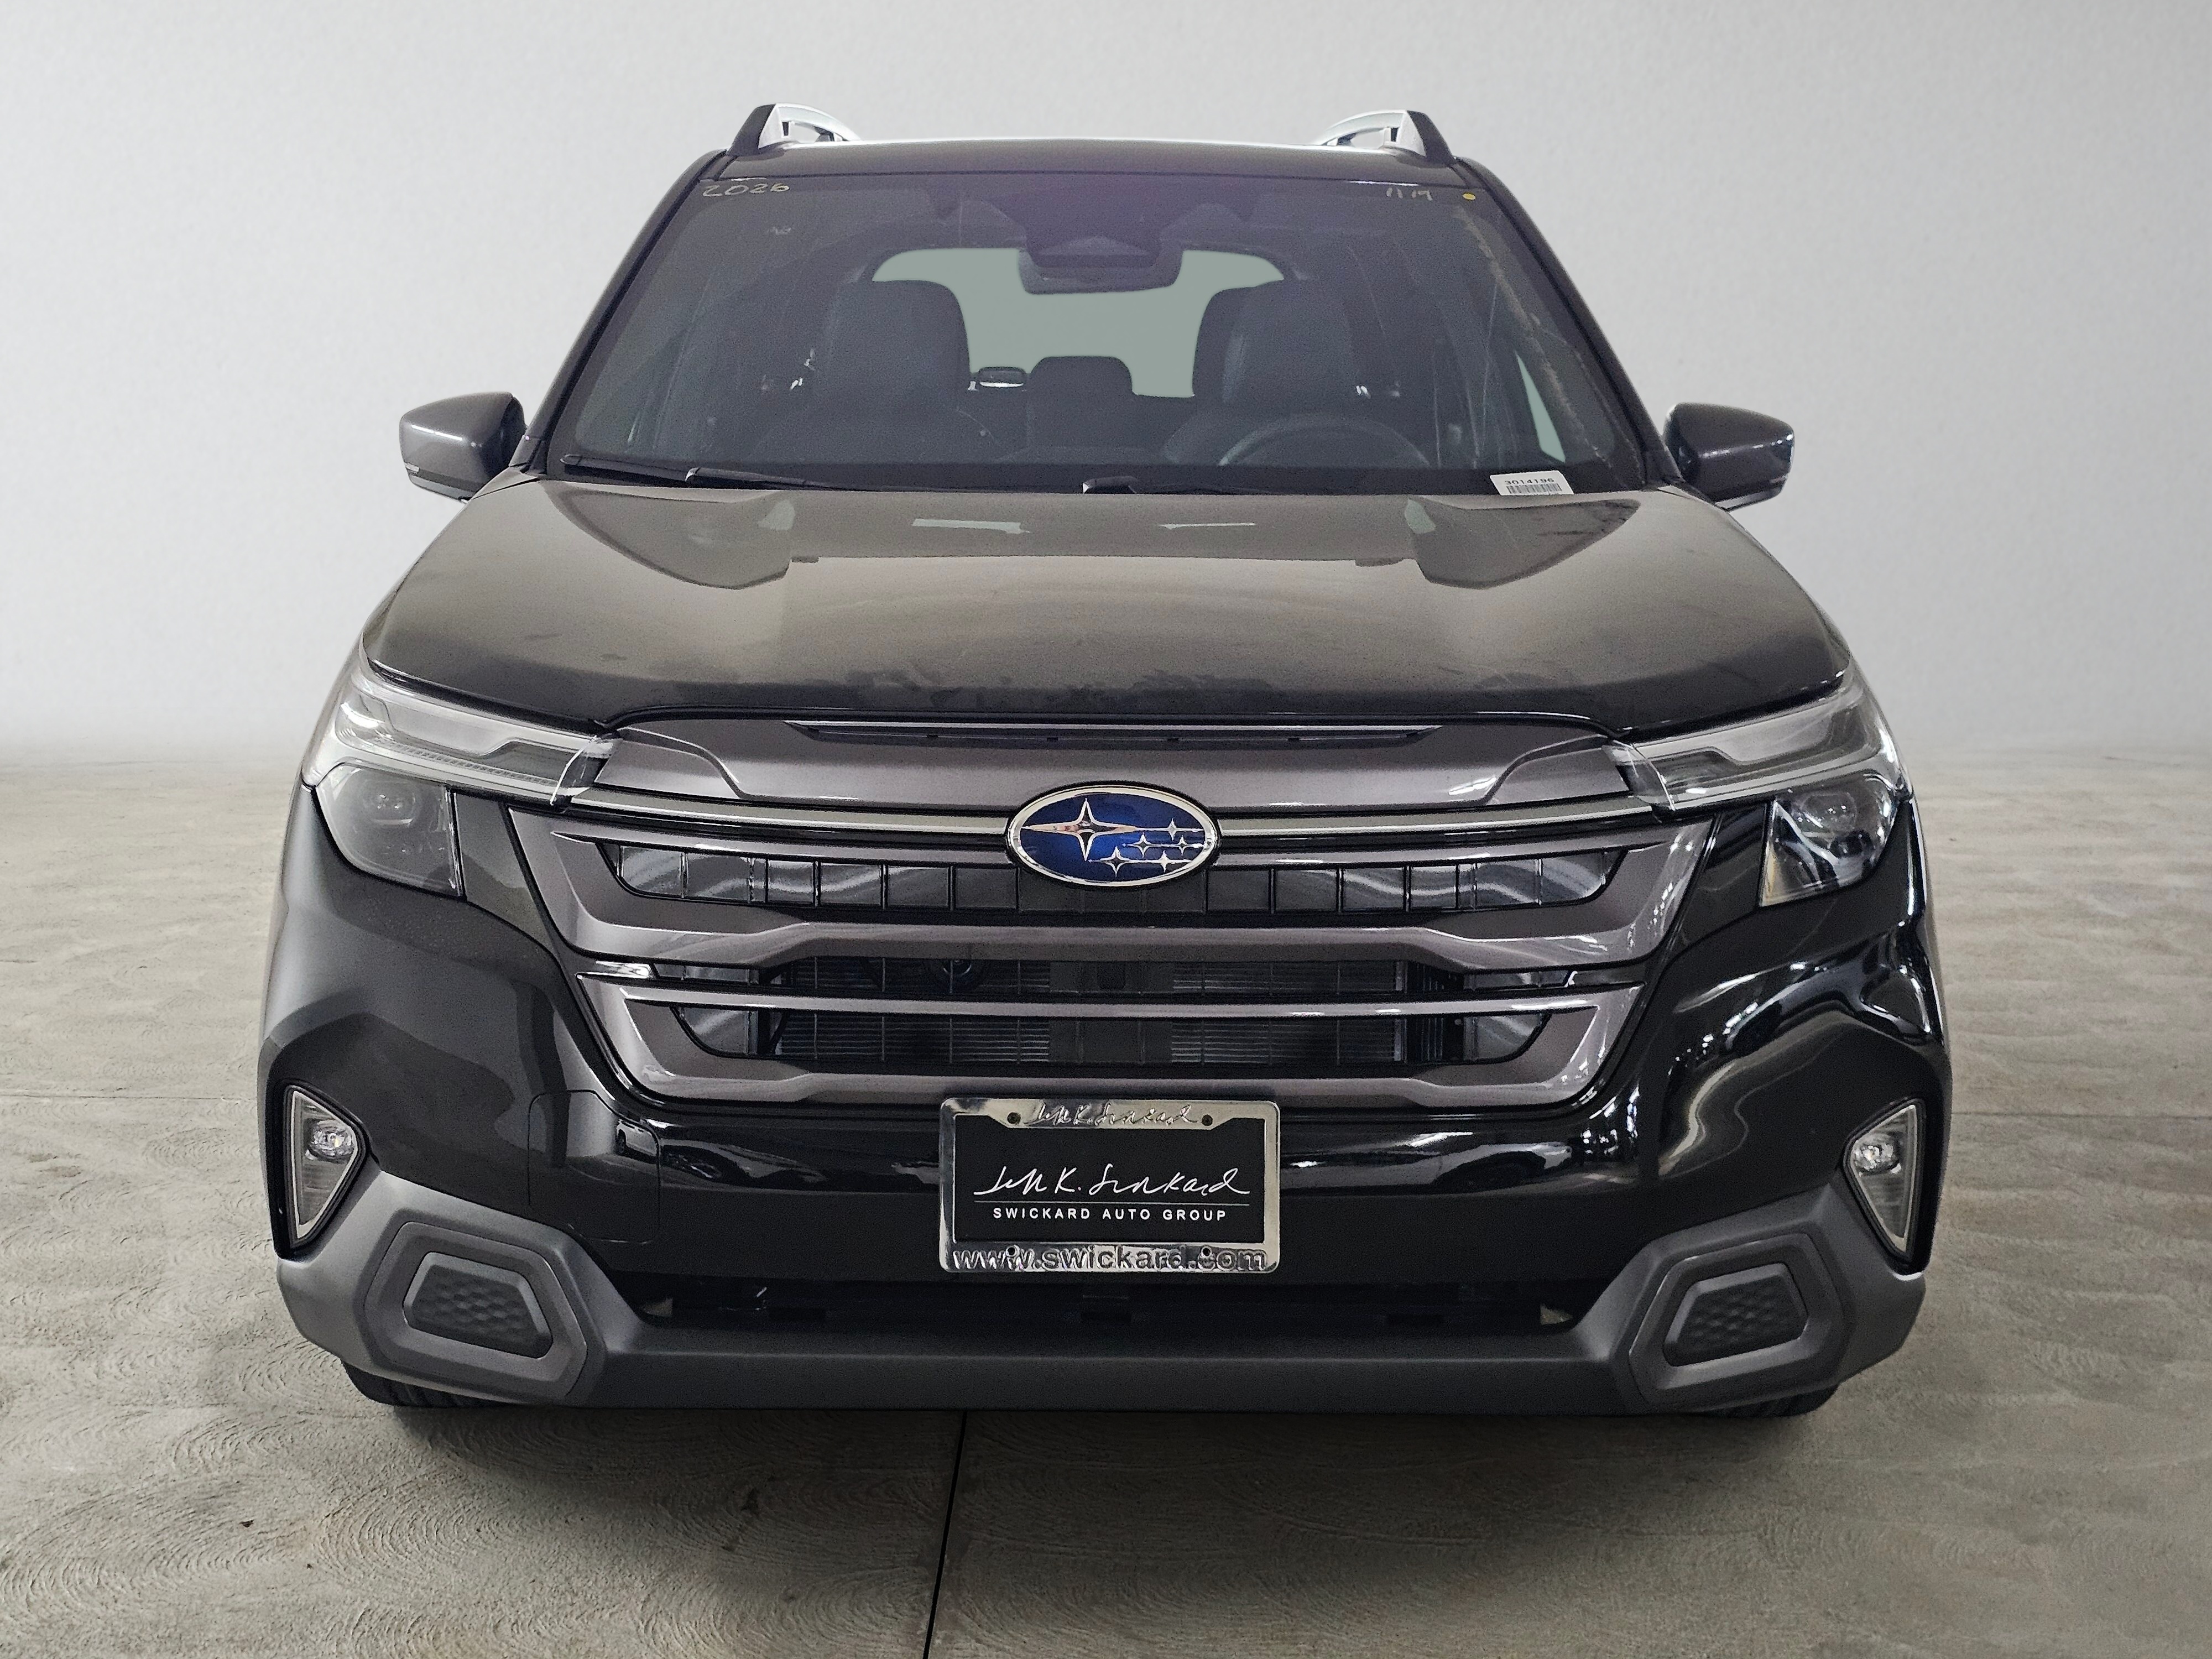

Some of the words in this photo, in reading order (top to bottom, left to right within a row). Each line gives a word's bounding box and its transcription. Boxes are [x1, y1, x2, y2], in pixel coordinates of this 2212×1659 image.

[702, 183, 790, 197] 2026
[993, 1208, 1091, 1220] SWICKARD
[1102, 1208, 1151, 1220] AUTO
[1162, 1209, 1227, 1222] GROUP
[952, 1245, 1267, 1271] www.swickard.com
